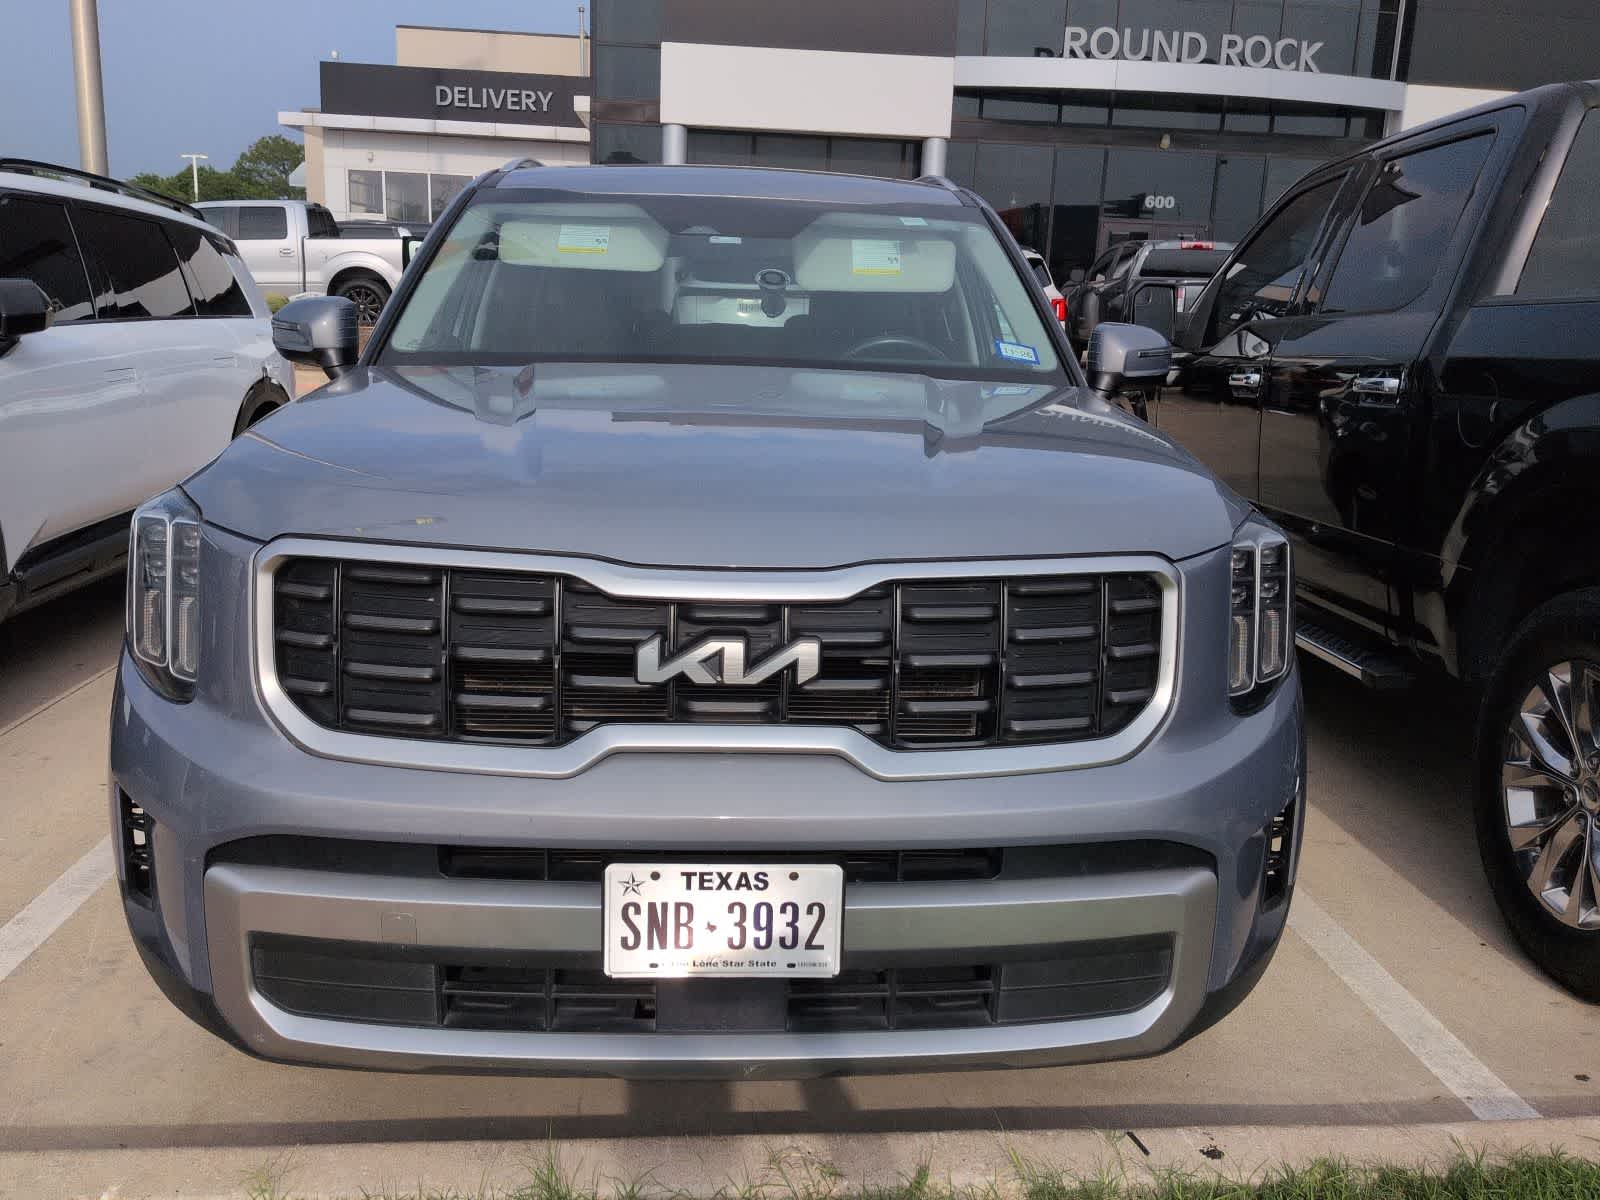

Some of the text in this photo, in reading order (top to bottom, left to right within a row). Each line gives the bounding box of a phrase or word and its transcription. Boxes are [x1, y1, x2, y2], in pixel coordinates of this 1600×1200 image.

[1063, 26, 1325, 73] ROUND ROCK
[435, 85, 553, 112] DELIVERY
[1144, 195, 1176, 209] 600
[680, 871, 769, 891] TEXAS
[620, 901, 826, 951] SNB 3932
[692, 959, 718, 968] Lone
[722, 960, 744, 968] Star
[748, 960, 777, 968] State
